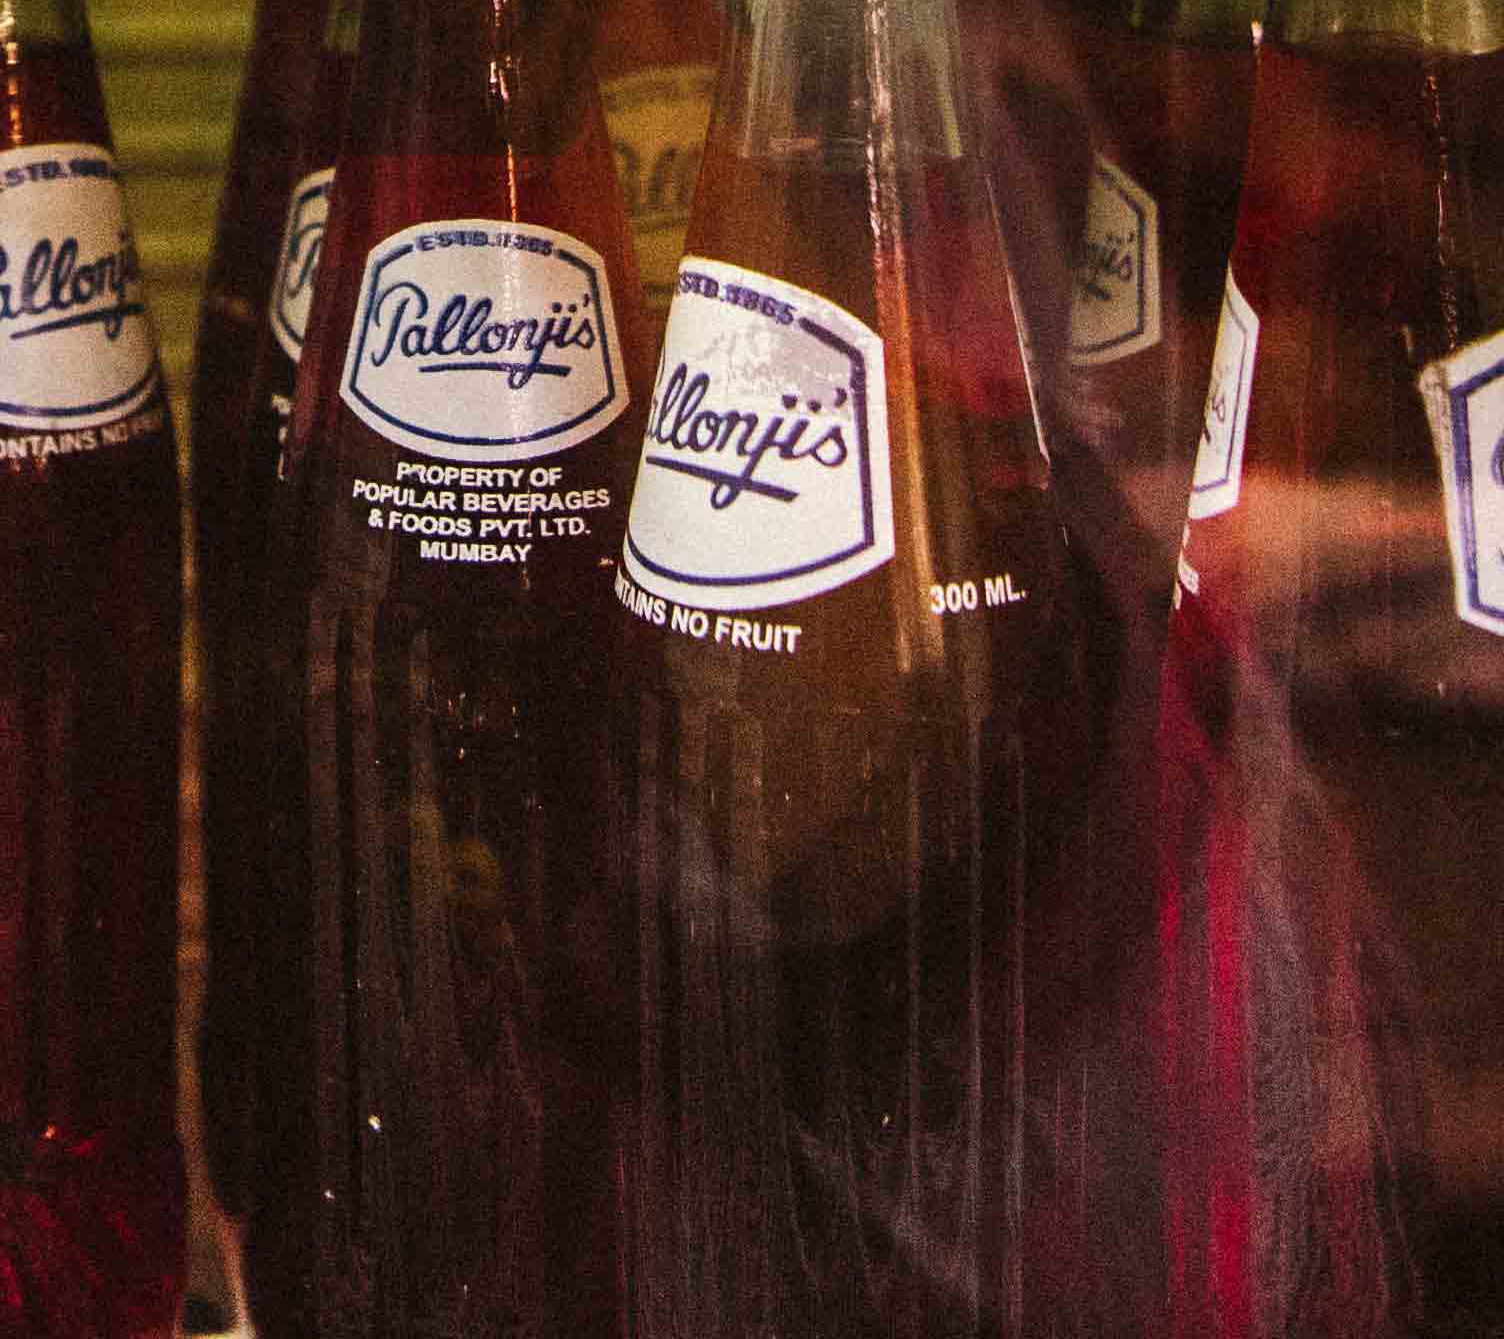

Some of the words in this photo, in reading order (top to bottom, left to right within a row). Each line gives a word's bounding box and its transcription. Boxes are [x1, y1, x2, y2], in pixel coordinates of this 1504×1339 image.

[370, 281, 596, 390] Pallonji's
[647, 361, 849, 510] llonji's
[395, 461, 525, 489] PROPERTY
[529, 466, 563, 488] OF
[351, 478, 457, 512] POPULAR
[462, 488, 611, 513] BEVERAGES
[368, 508, 384, 528] &
[387, 510, 472, 538] FOODS
[479, 519, 533, 538] PVT.
[540, 517, 592, 538] LTD.
[419, 539, 532, 563] MUMBAY
[929, 582, 979, 615] 300
[985, 574, 1028, 604] ML.
[670, 604, 709, 639] NO
[714, 615, 803, 655] FRUIT
